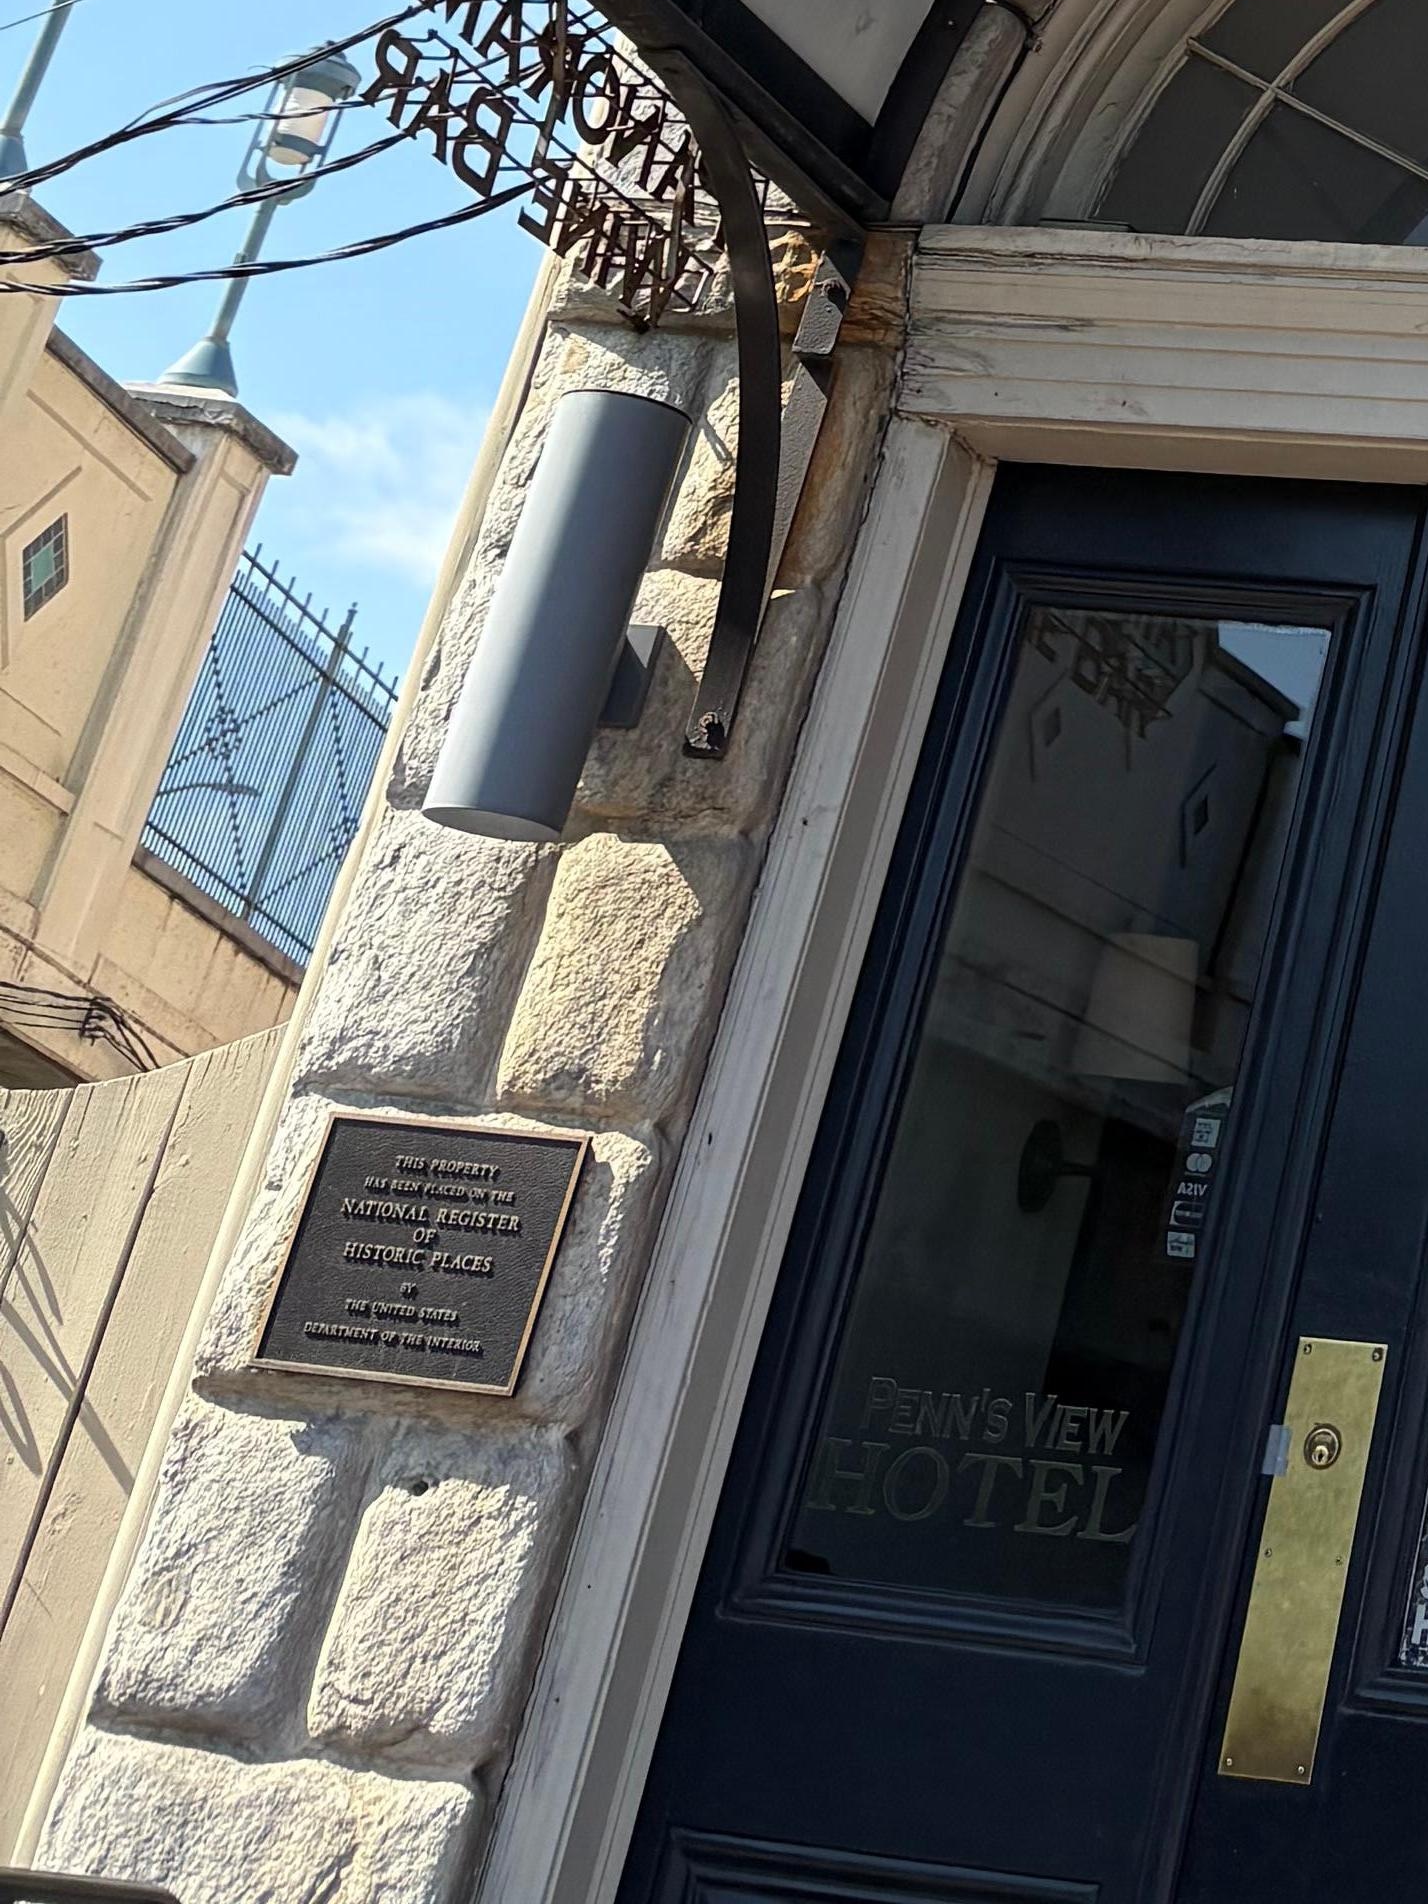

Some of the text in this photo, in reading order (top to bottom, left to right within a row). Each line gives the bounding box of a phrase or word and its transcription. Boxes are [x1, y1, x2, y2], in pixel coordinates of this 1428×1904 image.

[395, 1155, 499, 1177] THIS PROPERTY
[364, 1176, 515, 1203] HAS BEEN PLACED ON THE
[341, 1198, 520, 1231] NATIONAL REGISTER
[413, 1227, 437, 1243] OF
[343, 1242, 493, 1272] HISTORIC PLACES
[400, 1282, 416, 1294] BY
[344, 1299, 458, 1321] THE UNITED STATES
[304, 1321, 481, 1352] DEPARTMENT OF THE INTERIOR
[859, 1376, 1130, 1457] PENN'S VIEW
[803, 1437, 1137, 1545] HOTEL
